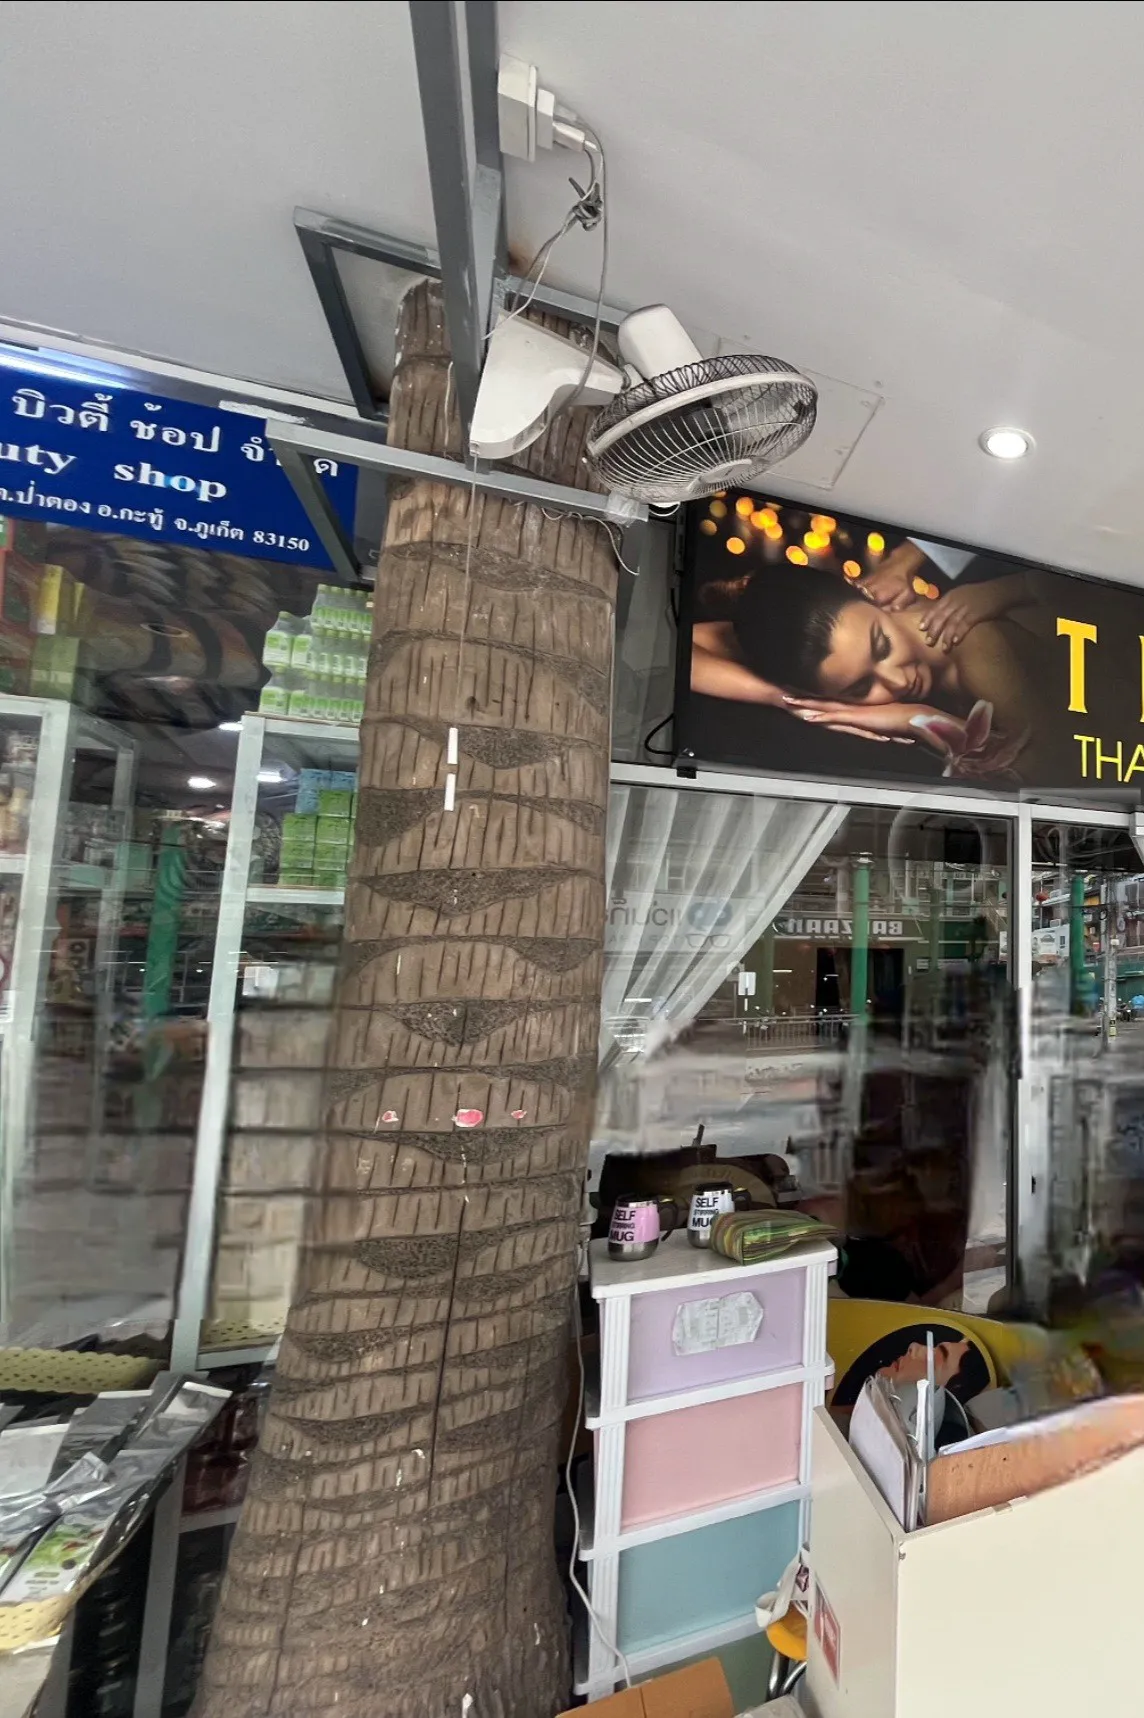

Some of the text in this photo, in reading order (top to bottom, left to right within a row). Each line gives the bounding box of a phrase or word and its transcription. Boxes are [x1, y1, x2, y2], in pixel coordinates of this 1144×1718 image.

[12, 388, 339, 478] บิวตี้ ช้อป จำด
[114, 461, 228, 503] shop
[253, 530, 311, 552] 83150
[696, 1196, 719, 1208] SELF
[614, 1208, 637, 1221] SELF
[609, 1231, 634, 1242] MUG
